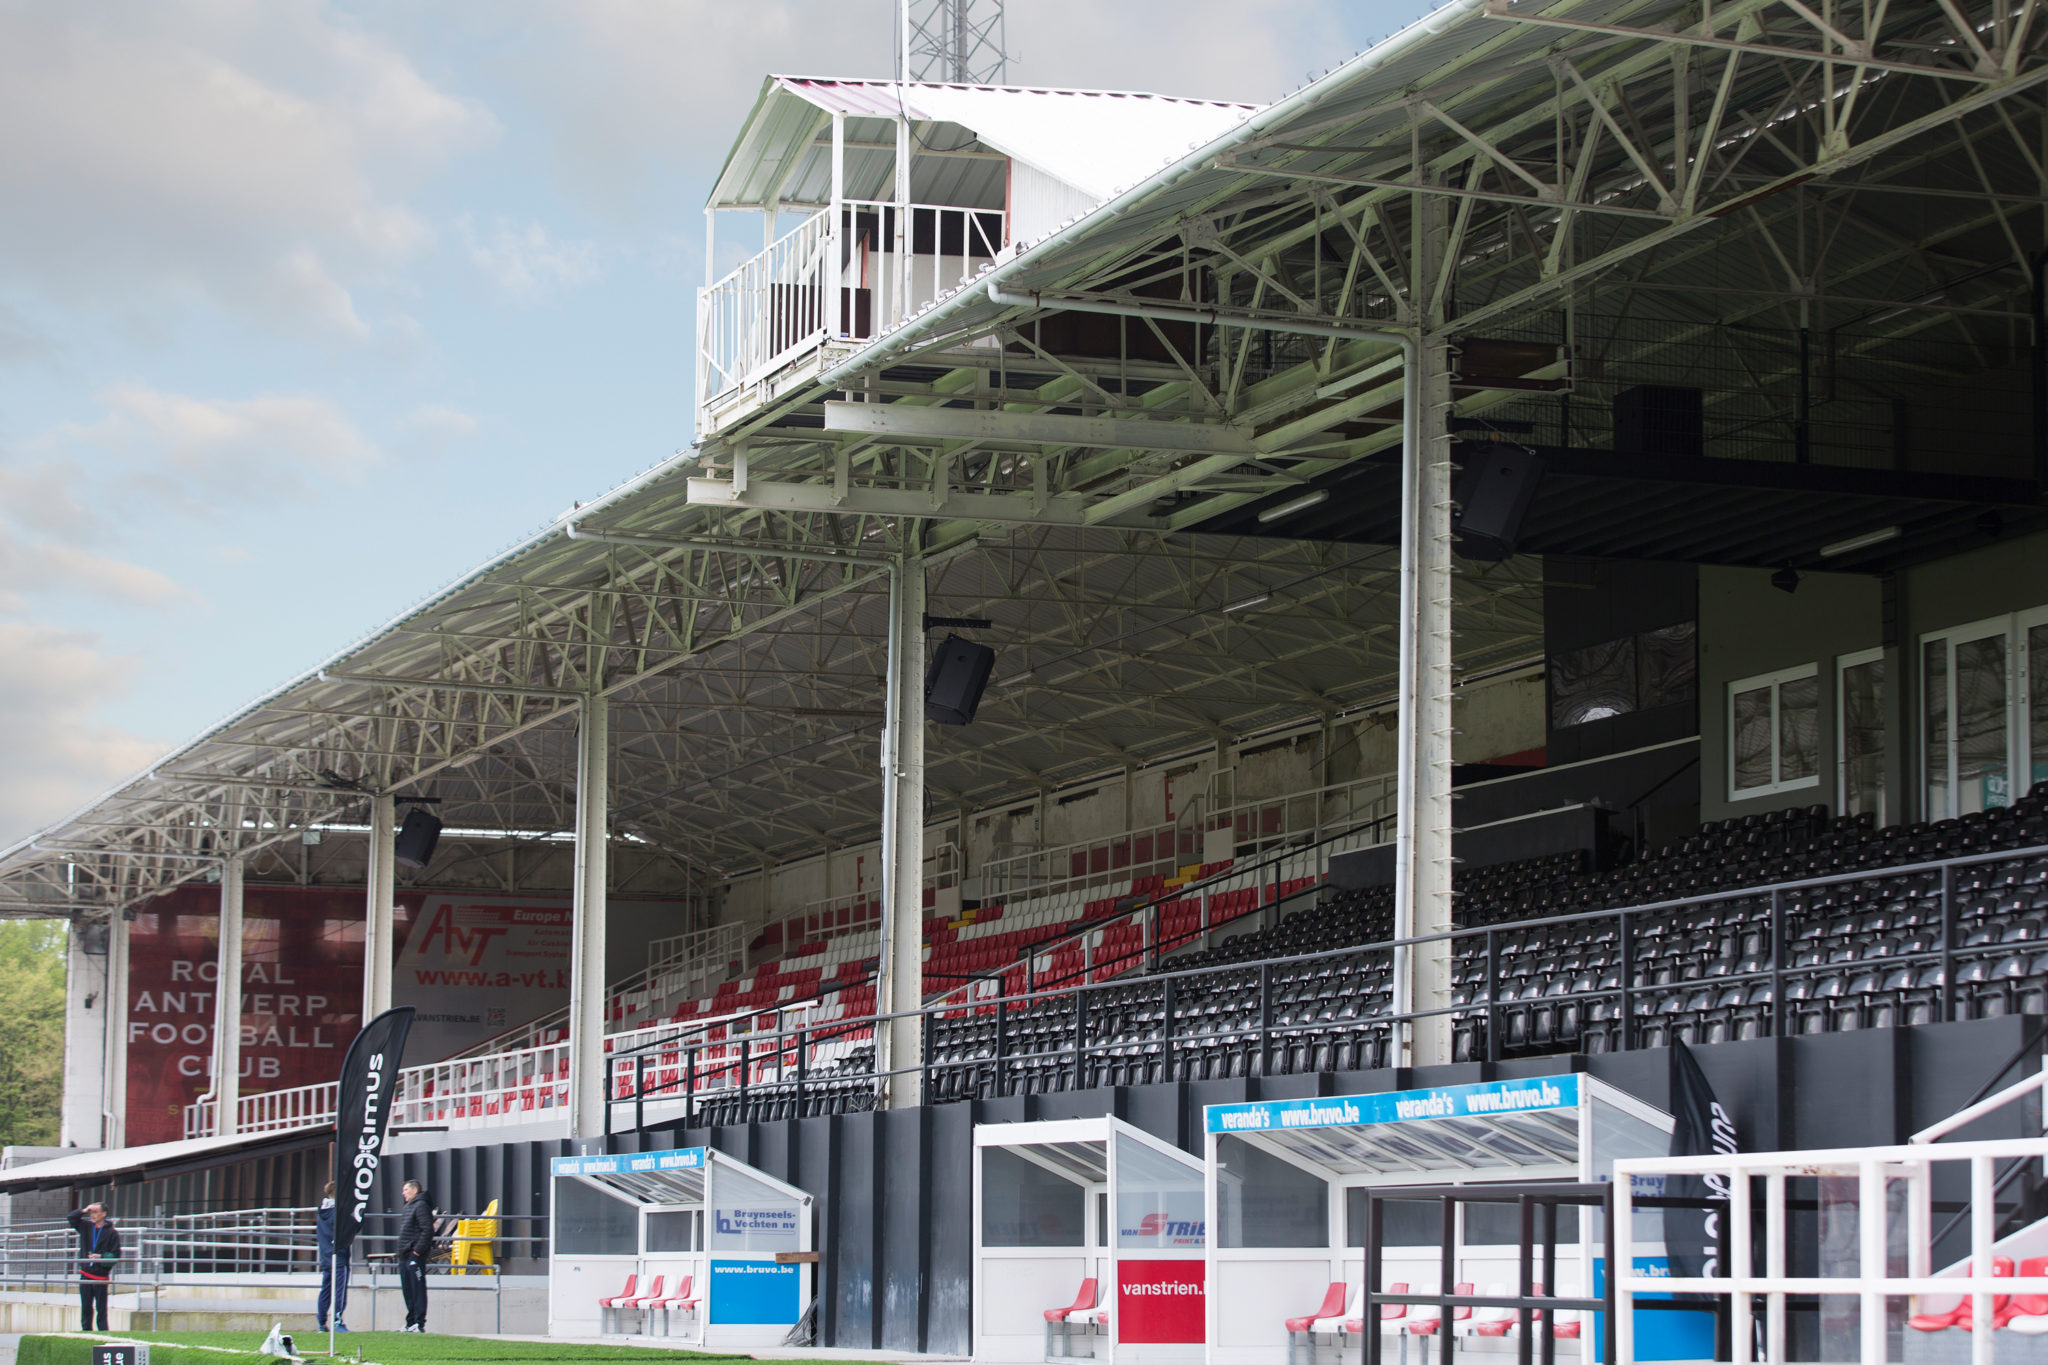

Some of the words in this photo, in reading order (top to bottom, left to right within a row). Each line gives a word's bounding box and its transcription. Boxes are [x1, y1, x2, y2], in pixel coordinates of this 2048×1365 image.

[514, 909, 561, 924] Europe
[171, 960, 295, 985] ROAL
[134, 990, 328, 1016] ANTERP
[128, 1021, 334, 1048] FOOBALL
[1221, 1106, 1270, 1130] veranda's
[1281, 1100, 1360, 1128] www.bruvo.be
[1396, 1091, 1454, 1119] veranda's
[1466, 1081, 1561, 1113] www.bruvo.be
[734, 1210, 796, 1220] Bruynseels-
[714, 1265, 794, 1274] www.bruvo.be
[1122, 1280, 1206, 1296] vanstrien.
